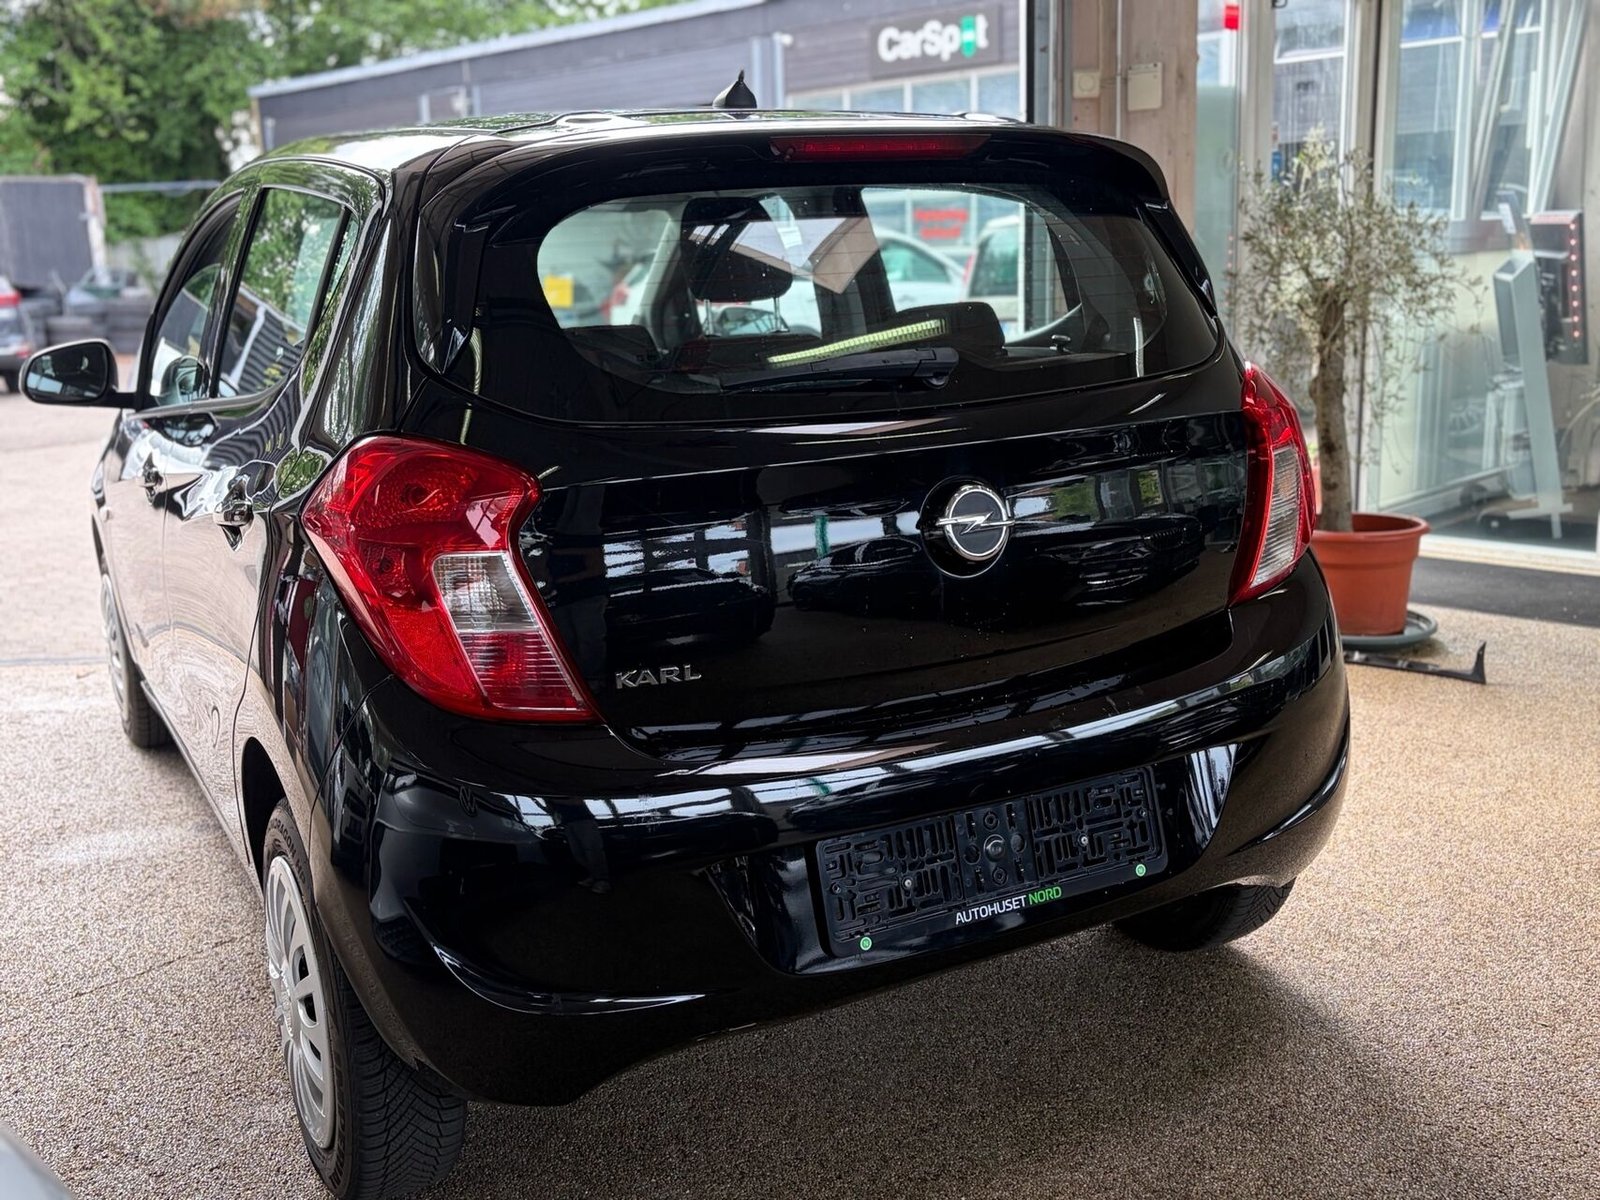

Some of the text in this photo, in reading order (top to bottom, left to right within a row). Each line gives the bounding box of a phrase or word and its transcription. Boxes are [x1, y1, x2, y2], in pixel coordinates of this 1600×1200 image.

[615, 664, 702, 689] KARL
[955, 886, 1063, 926] AUTOHUSET NORD
